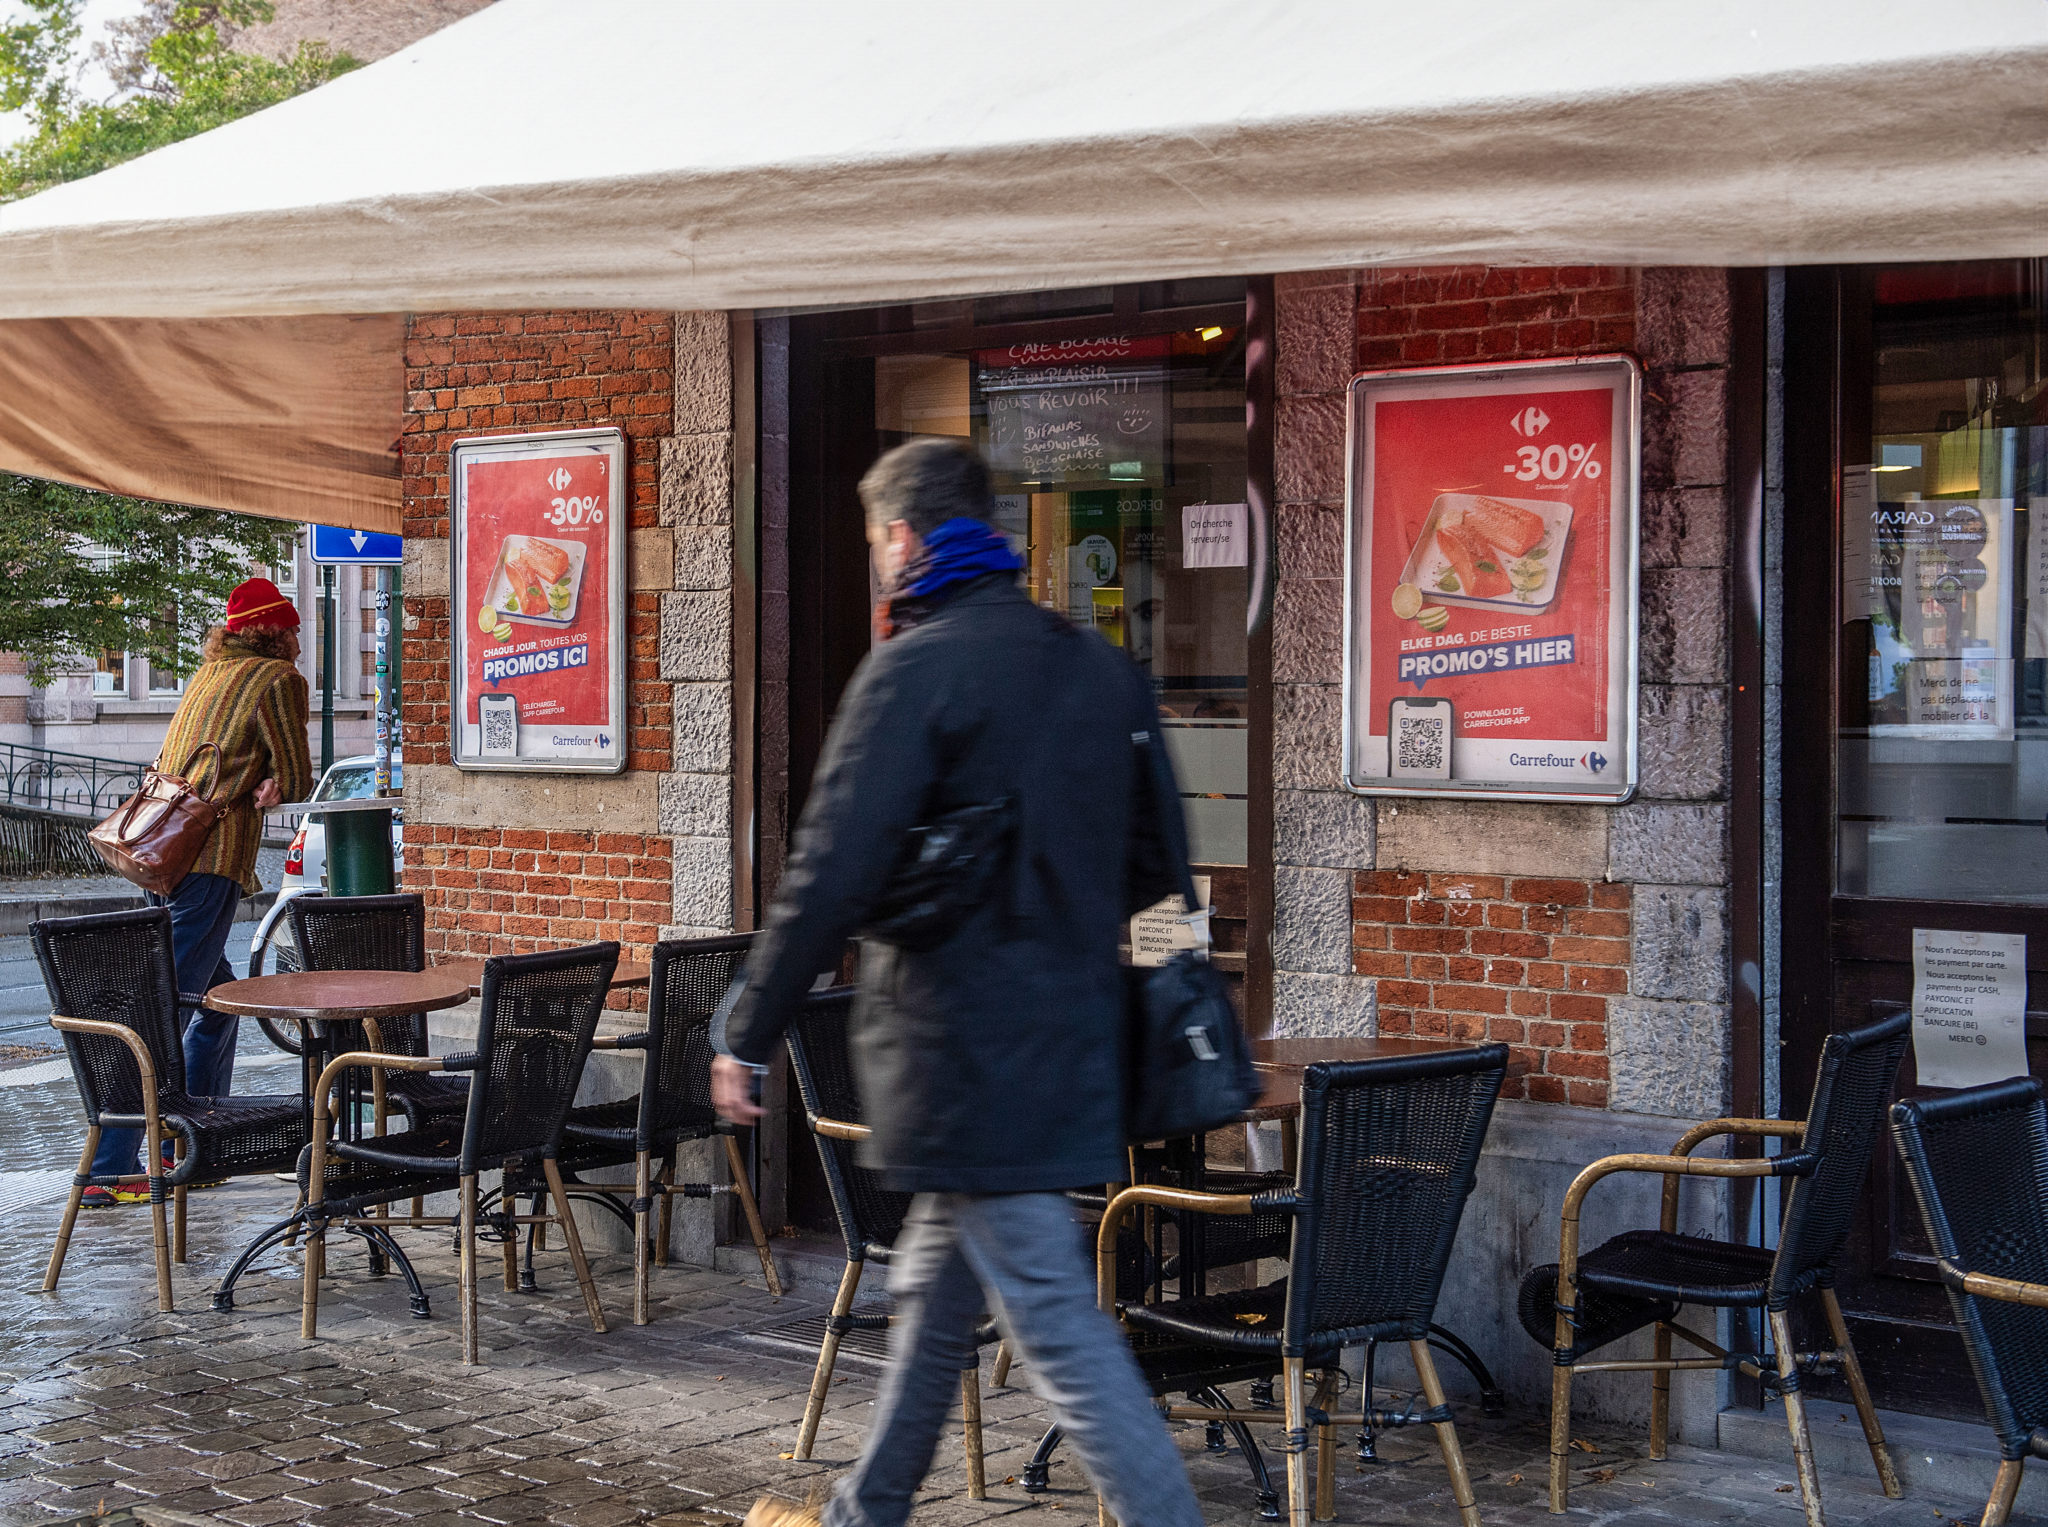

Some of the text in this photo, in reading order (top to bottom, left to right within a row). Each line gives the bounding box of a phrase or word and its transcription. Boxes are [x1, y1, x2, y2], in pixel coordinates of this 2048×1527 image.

[989, 396, 1031, 415] VOUS
[1039, 388, 1109, 411] REVOIR
[1503, 443, 1602, 481] -30%
[544, 496, 603, 525] -30%
[1190, 519, 1233, 529] On cherche
[1190, 534, 1230, 544] serveur/se
[1401, 624, 1532, 651] ELKE DAG, DE BESTE
[483, 633, 588, 658] CHAQUE JOUR, TOUTES VOS
[1515, 639, 1573, 664] HIER
[483, 646, 587, 680] PROMOS ICI
[1919, 678, 1979, 687] Merci de ne
[1920, 696, 1937, 705] pas
[1939, 693, 1983, 705] déplacer
[536, 706, 565, 716] CARREFOUR
[1463, 707, 1525, 719] DOWNLOAD DE
[1920, 710, 1990, 721] mobilier de la
[1463, 716, 1531, 729] CARREFOUR-APP
[552, 735, 591, 746] Carrefour
[1509, 752, 1575, 768] Carrefour
[1153, 908, 1180, 916] acceptons
[1138, 936, 1173, 945] APPLICATION
[1925, 946, 1944, 954] Nous
[1992, 950, 2005, 958] pas
[1925, 957, 2008, 970] les payment par carte.
[1926, 971, 1997, 983] Nous acceptons les
[1926, 983, 2001, 996] payments par CASH,
[1925, 994, 1963, 1004] PAYCONIC
[1924, 1006, 1974, 1017] APPLICATION
[1924, 1018, 1978, 1030] BANCAIRE (BE)
[1948, 1034, 1974, 1043] MERCI
